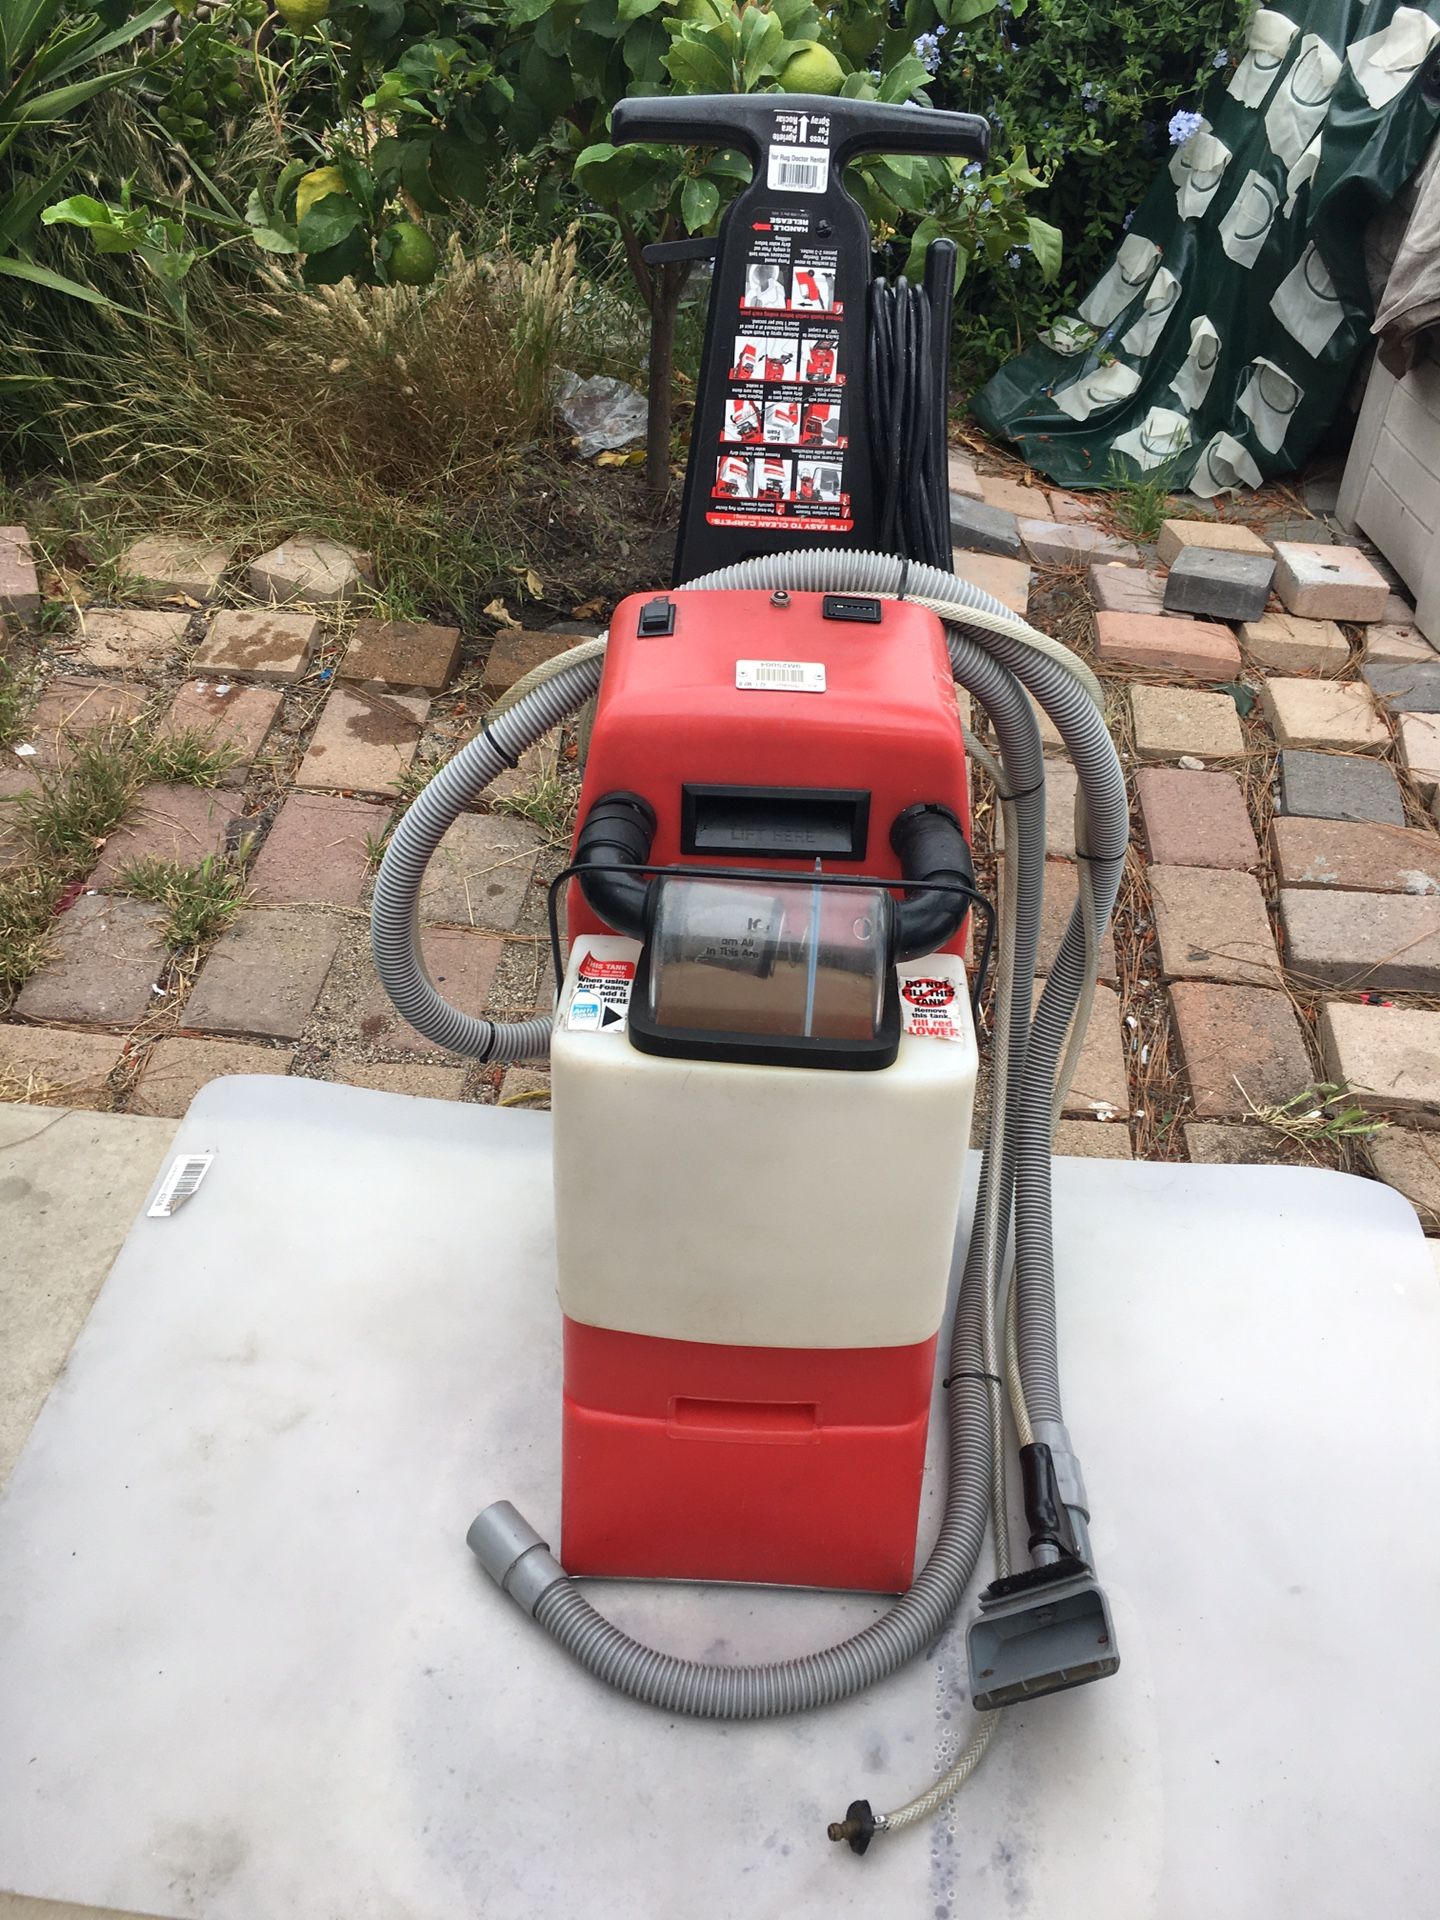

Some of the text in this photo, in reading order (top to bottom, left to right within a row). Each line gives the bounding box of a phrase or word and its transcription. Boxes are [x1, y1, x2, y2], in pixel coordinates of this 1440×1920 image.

[810, 116, 830, 127] Spray
[781, 125, 798, 134] Para
[818, 127, 829, 136] For
[809, 136, 829, 145] Press
[770, 217, 809, 225] RELEASE
[731, 828, 816, 843] LIFT HERE
[578, 974, 630, 986] When using
[906, 980, 949, 988] DO NOT
[902, 988, 955, 997] FILL THIS
[915, 998, 946, 1006] TANK
[907, 1026, 961, 1037] LOWER
